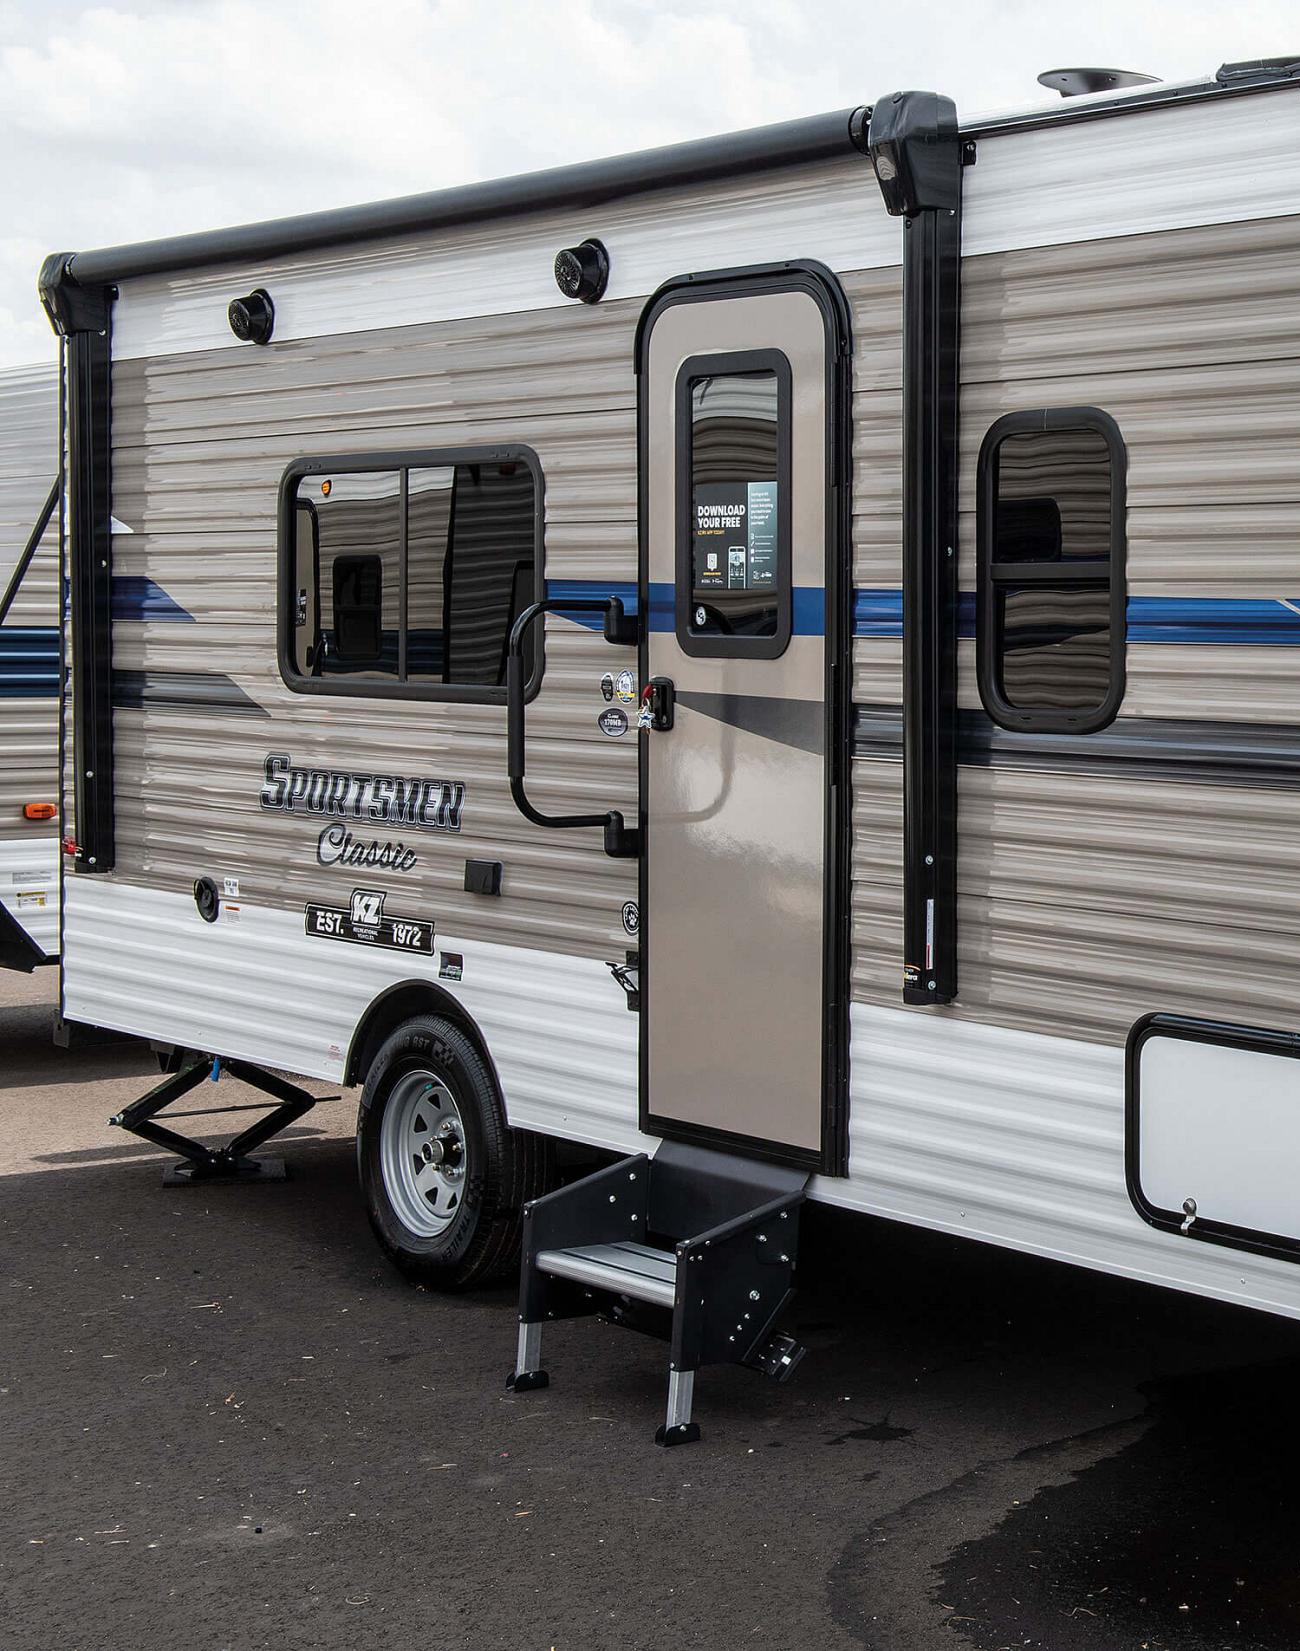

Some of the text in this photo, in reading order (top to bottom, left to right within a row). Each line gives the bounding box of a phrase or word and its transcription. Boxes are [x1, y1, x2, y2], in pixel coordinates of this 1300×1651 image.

[697, 504, 746, 517] DOWNLOAD
[697, 516, 741, 528] YOUR FREE
[260, 751, 467, 833] SPORTSMEN
[315, 822, 418, 873] Classic
[353, 894, 380, 925] KZ
[316, 911, 423, 947] EST. 1972
